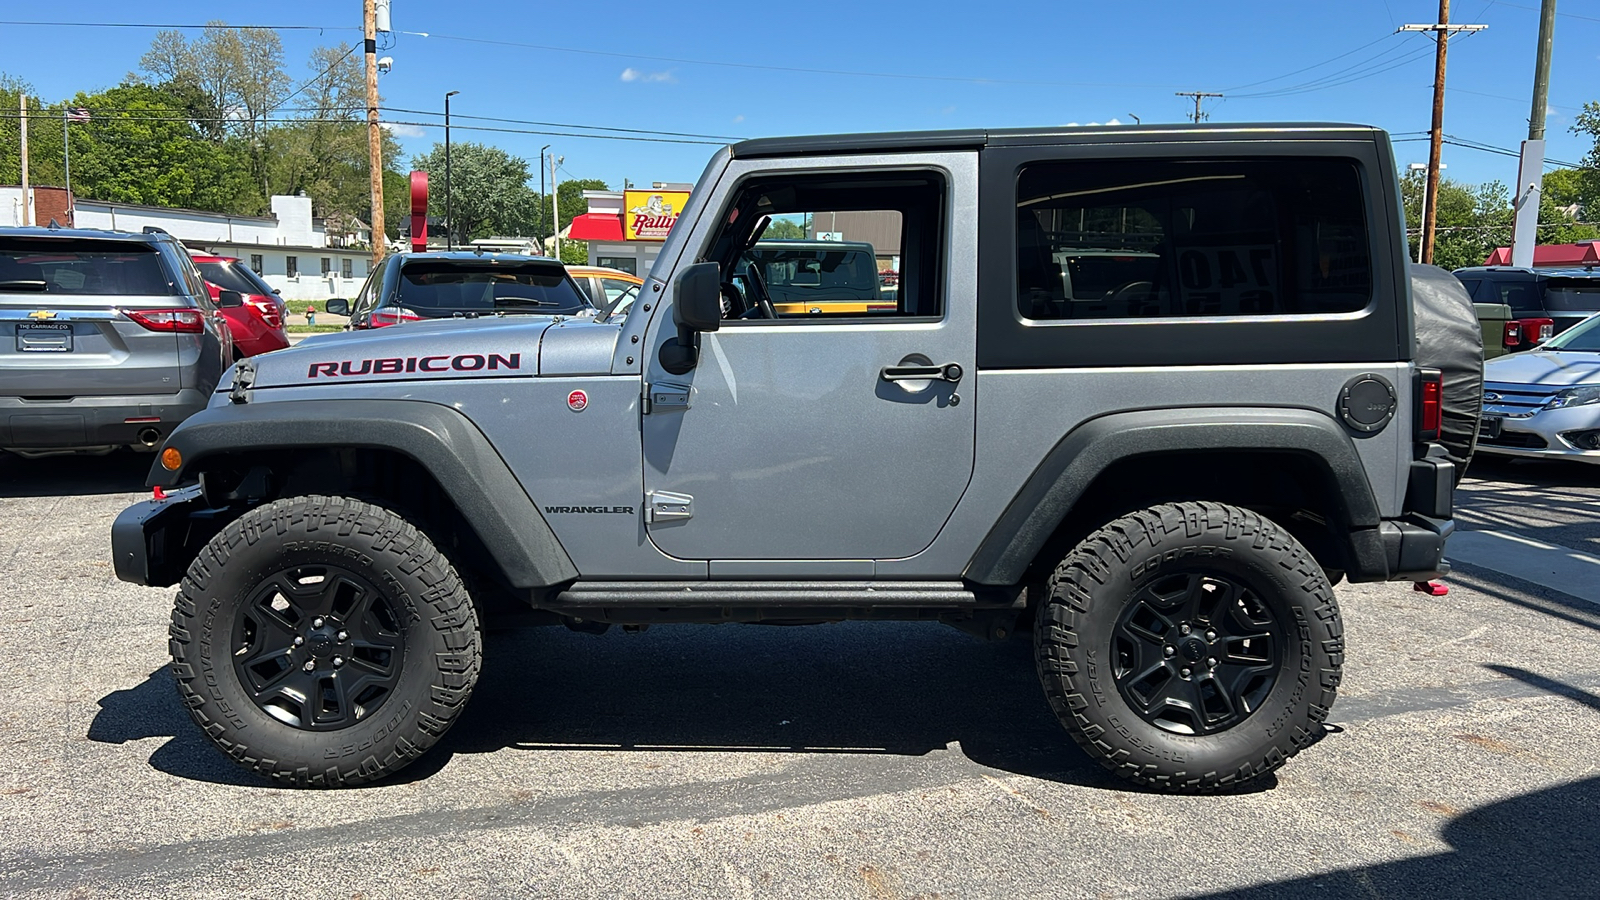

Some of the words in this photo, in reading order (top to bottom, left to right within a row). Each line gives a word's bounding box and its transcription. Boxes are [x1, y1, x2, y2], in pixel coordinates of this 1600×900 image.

[308, 353, 520, 378] RUBICON
[1367, 403, 1387, 411] Jeep
[545, 506, 634, 514] WRANGLER
[1130, 545, 1233, 581] COOPER
[200, 597, 248, 731] DISCOVERER
[1086, 649, 1105, 707] TREK
[1264, 606, 1313, 738] DISCOVERER
[323, 700, 412, 760] COOPER
